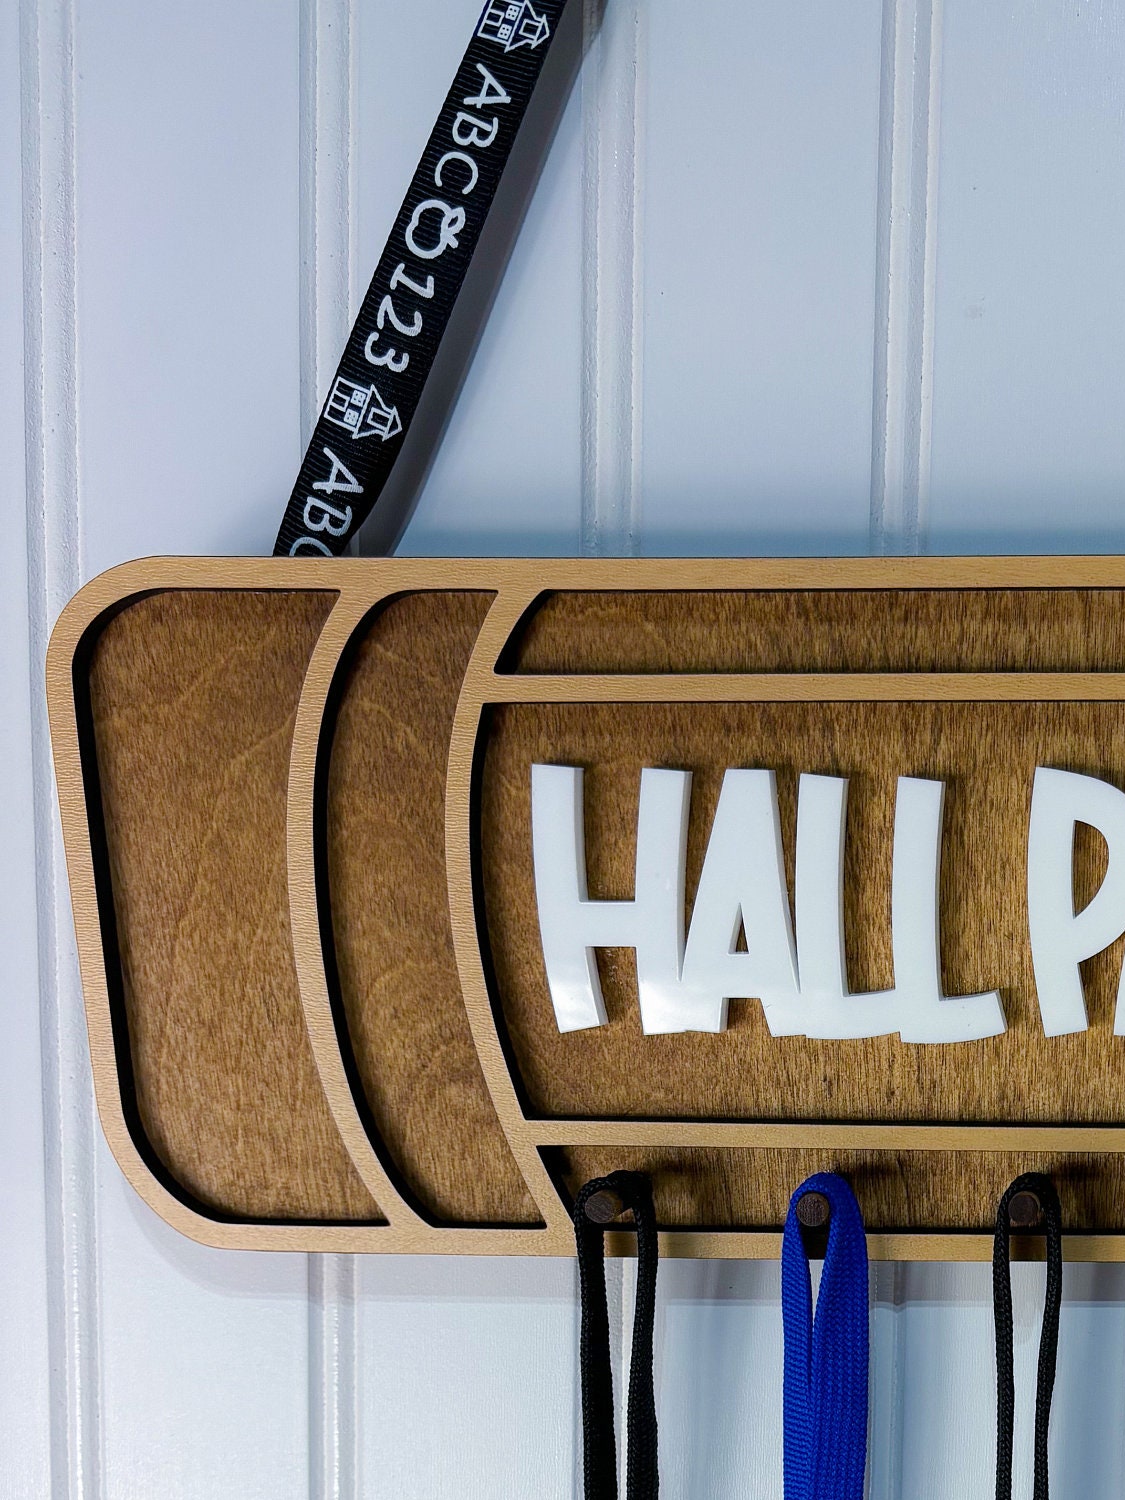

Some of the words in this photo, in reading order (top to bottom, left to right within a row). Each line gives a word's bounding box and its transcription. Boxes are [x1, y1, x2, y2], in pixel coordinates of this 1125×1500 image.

[435, 63, 512, 194] ABC
[365, 263, 434, 373] 123
[531, 763, 1006, 1044] HALL
